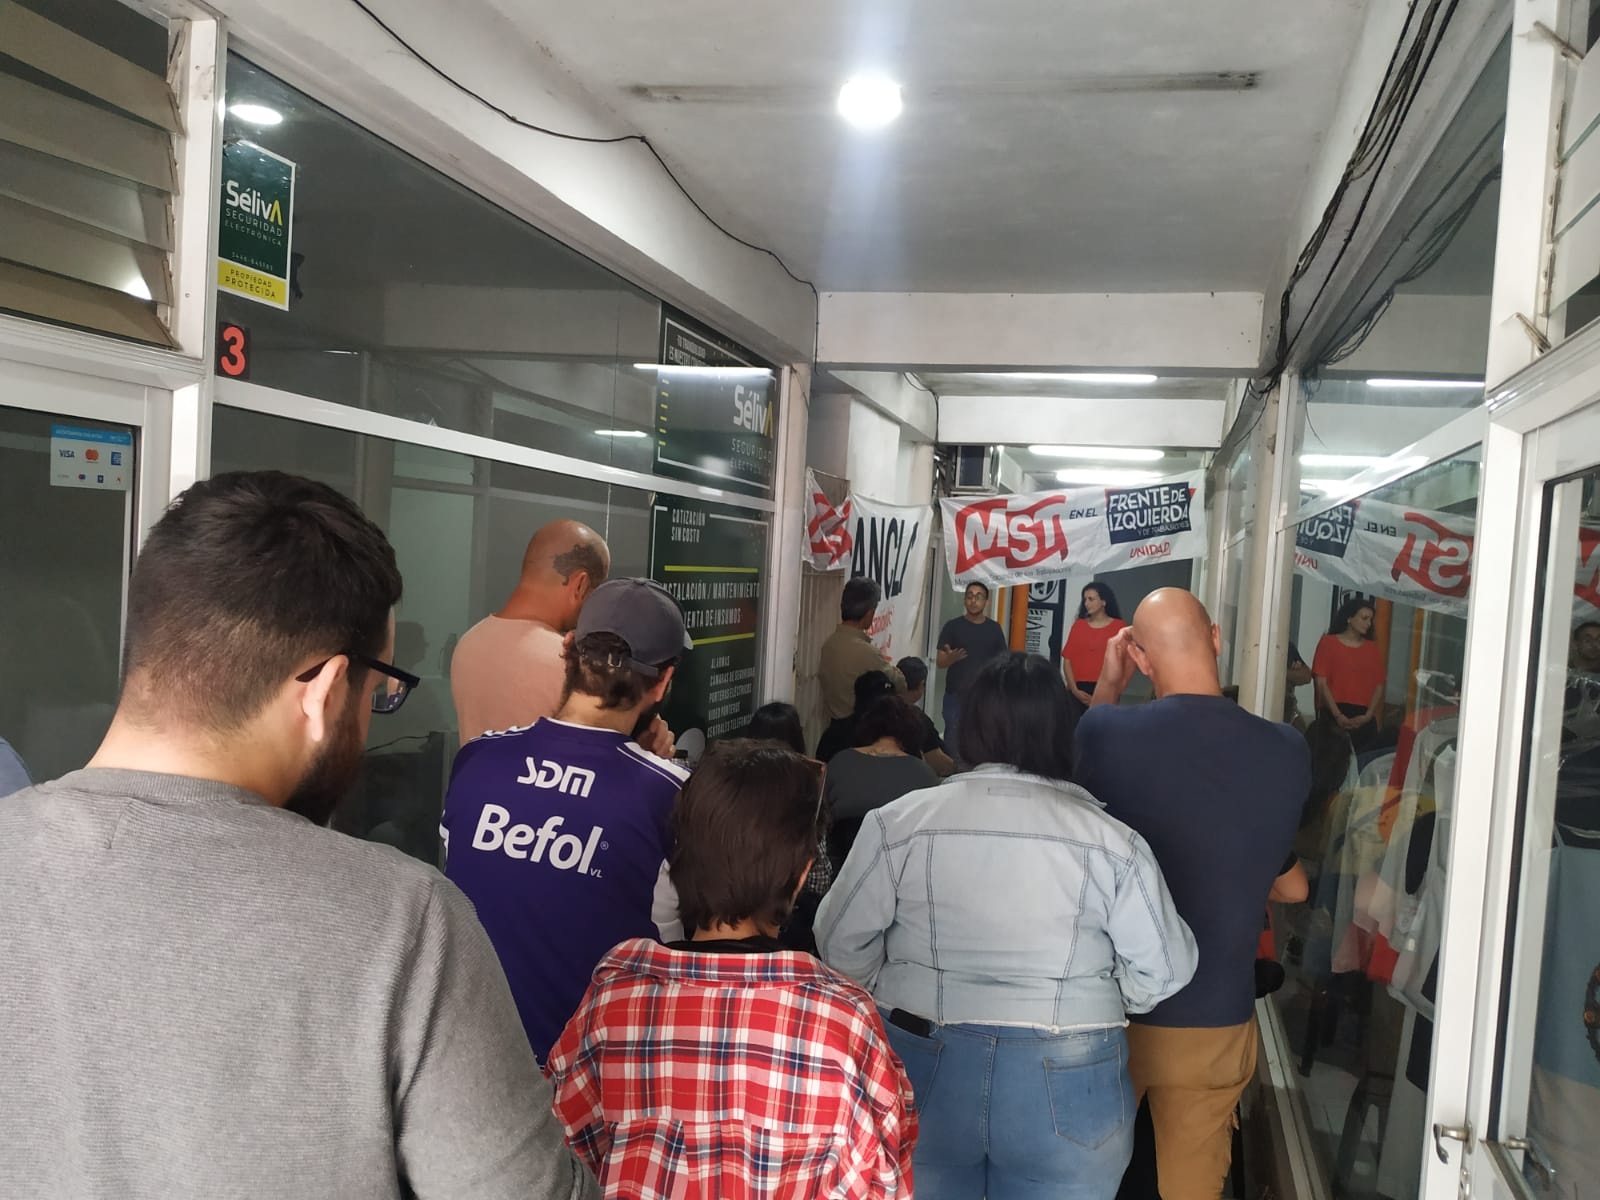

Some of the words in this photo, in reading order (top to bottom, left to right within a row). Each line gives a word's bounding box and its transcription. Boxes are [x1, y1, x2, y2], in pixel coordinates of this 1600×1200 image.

[225, 208, 283, 237] SEGURIDAD
[225, 275, 276, 299] PROTEGIDA
[230, 269, 272, 288] PROPIEDAD
[220, 326, 246, 376] 3
[59, 449, 76, 458] VISA
[1108, 486, 1170, 513] FRENTE
[1171, 488, 1187, 504] DE
[1108, 503, 1189, 532] IZQUIERDA
[671, 526, 682, 541] SIN
[682, 527, 700, 543] COSTO
[962, 503, 1065, 563] MST
[1069, 508, 1085, 520] EN
[1086, 507, 1098, 518] EL
[1129, 541, 1171, 558] UNIDAD
[661, 580, 707, 600] NSTALACIÓN
[705, 609, 714, 626] DE
[517, 756, 596, 798] SDM
[472, 803, 604, 875] Befol
[590, 867, 603, 878] VL
